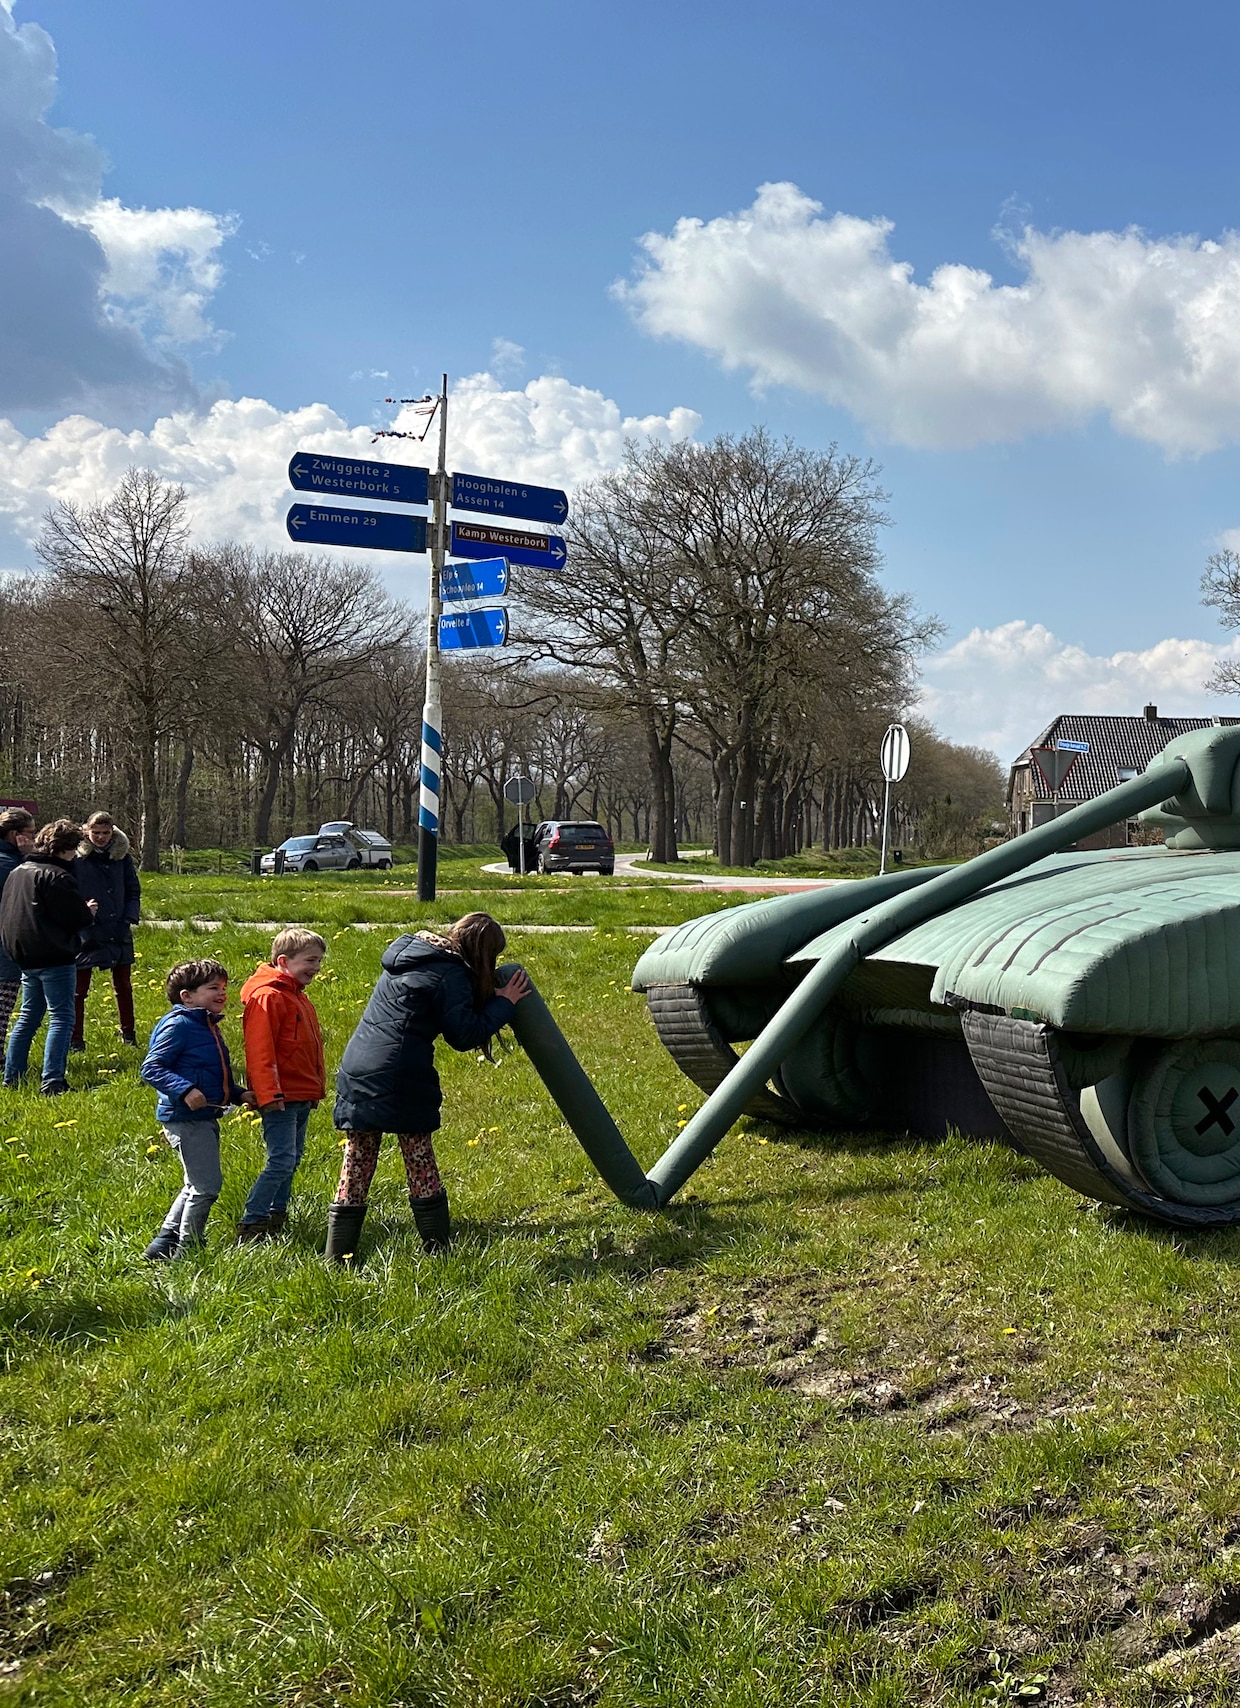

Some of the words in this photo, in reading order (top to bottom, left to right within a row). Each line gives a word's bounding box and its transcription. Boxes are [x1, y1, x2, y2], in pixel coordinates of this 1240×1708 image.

[312, 459, 379, 477] Zwiggelte
[384, 470, 390, 478] 2
[311, 474, 389, 493] Westerbork
[393, 486, 400, 494] 5
[457, 478, 518, 496] Hooghalen
[521, 490, 528, 498] 6
[456, 493, 490, 506] Assen
[494, 500, 504, 509] 14
[310, 510, 359, 524] Emmen
[363, 517, 377, 526] 29
[458, 527, 487, 541] Kamp
[489, 531, 546, 548] Westerbork
[442, 570, 453, 581] Elp
[476, 582, 484, 591] 14
[441, 618, 464, 630] Orvelte
